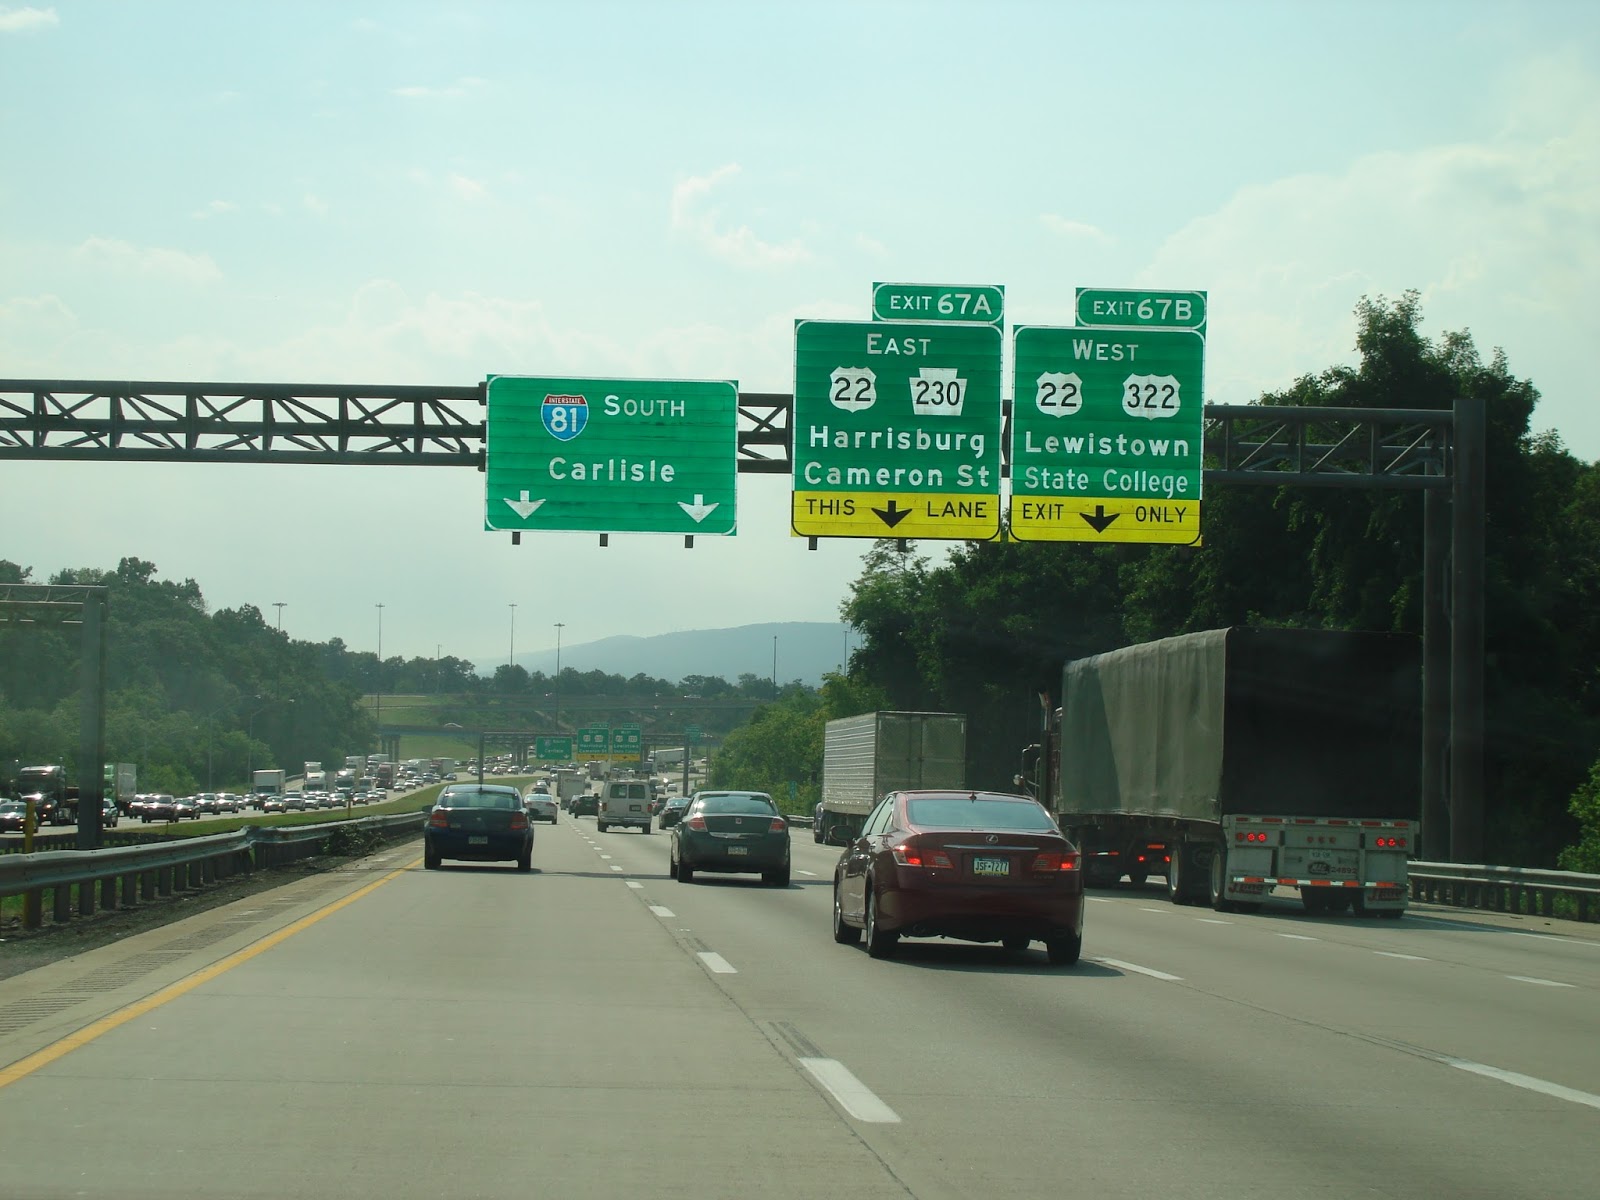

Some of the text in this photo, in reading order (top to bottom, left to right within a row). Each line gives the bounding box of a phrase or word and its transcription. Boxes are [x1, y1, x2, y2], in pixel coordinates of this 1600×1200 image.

[890, 293, 992, 315] EXIT 67A
[1093, 298, 1192, 321] EXIT 67B
[866, 333, 931, 356] EAST
[1072, 338, 1139, 361] WEST
[834, 377, 871, 402] 22
[915, 380, 961, 406] 230
[1040, 382, 1077, 408] 22
[1127, 383, 1175, 409] 322
[603, 394, 685, 417] SOUTH
[550, 406, 577, 433] 81
[810, 425, 985, 459] Harrisburg
[1025, 431, 1189, 457] Lewistown
[549, 457, 675, 482] Carlisle
[804, 461, 990, 488] Cameron St
[1024, 466, 1189, 500] State College
[805, 498, 987, 518] THIS LANE
[1023, 503, 1187, 523] EXIT ONLY
